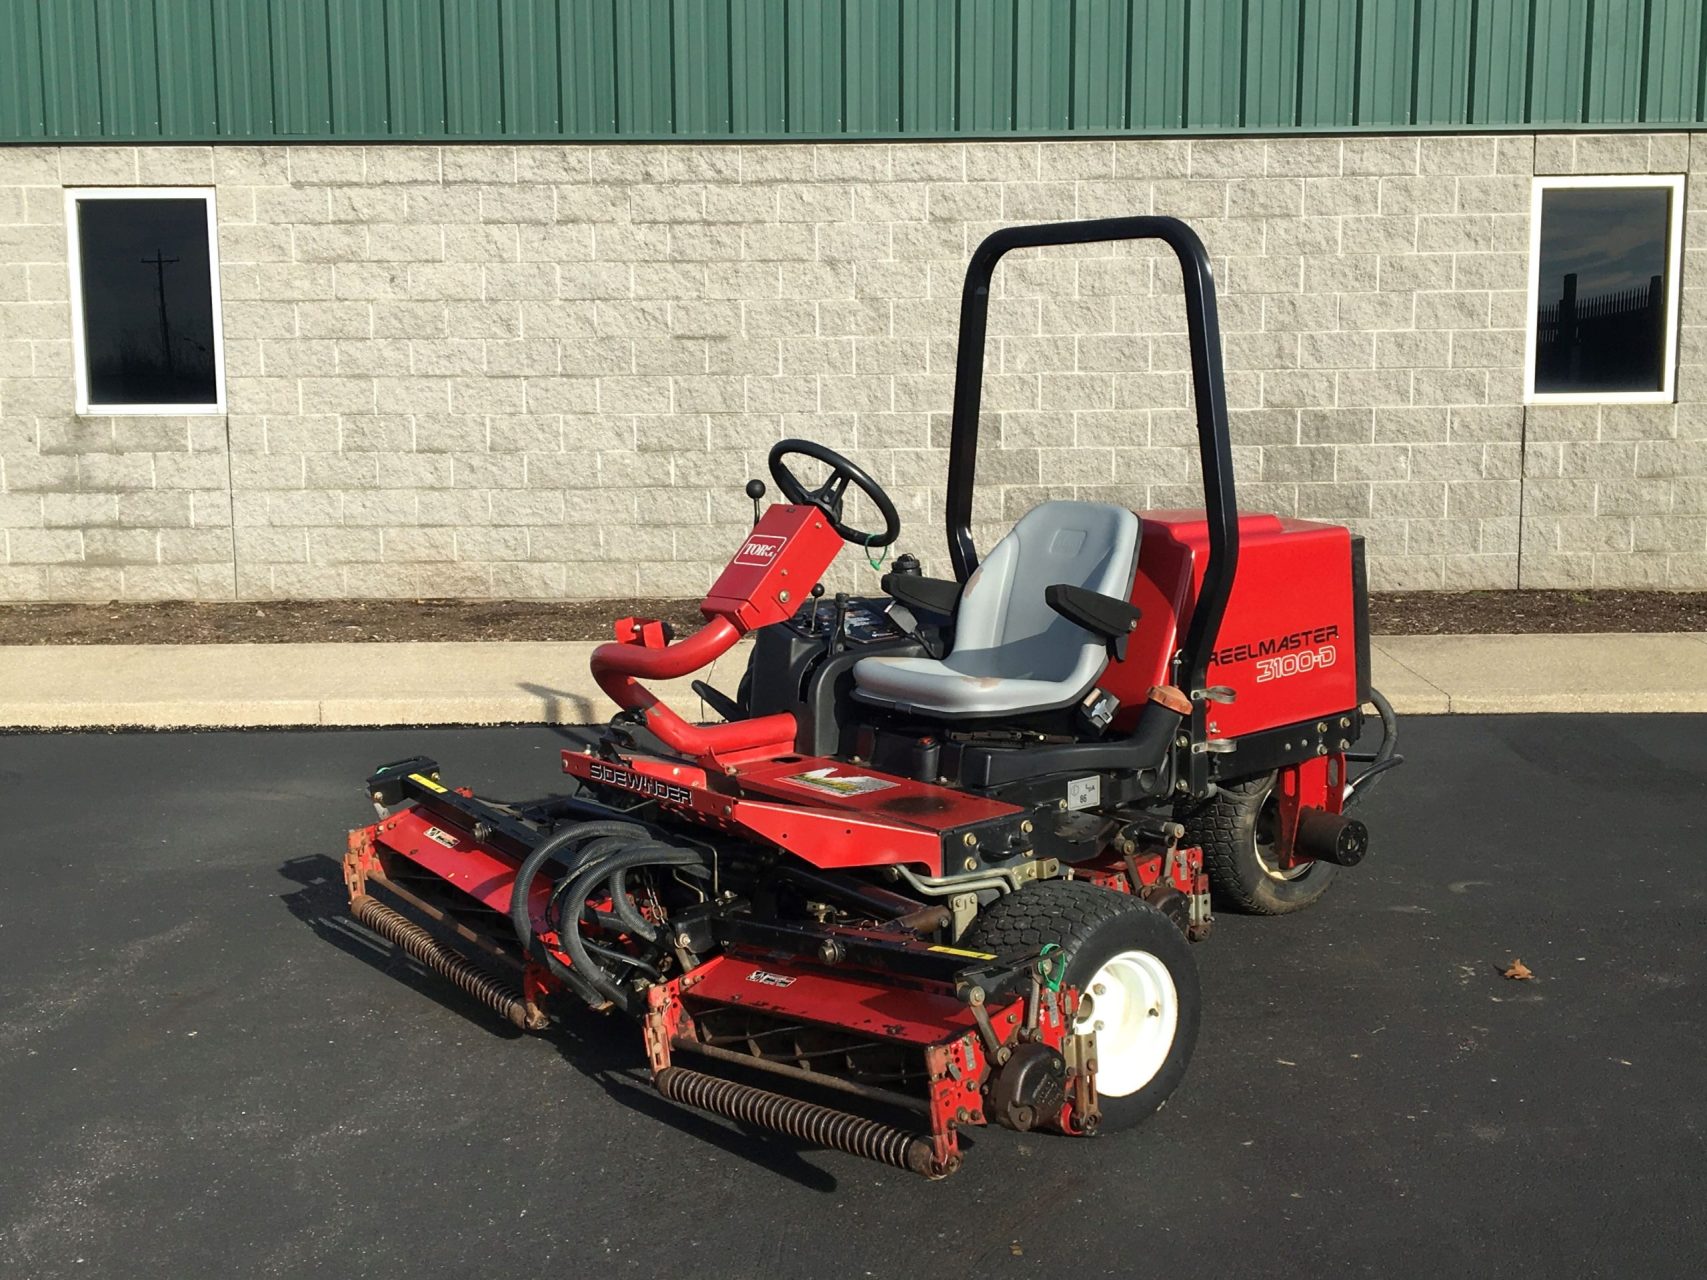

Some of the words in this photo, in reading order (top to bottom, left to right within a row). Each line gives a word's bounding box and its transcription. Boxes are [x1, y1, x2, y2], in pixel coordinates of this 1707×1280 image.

[743, 543, 776, 557] TORO
[1209, 625, 1339, 666] REELMASTER
[590, 764, 693, 807] SIDEWINDER
